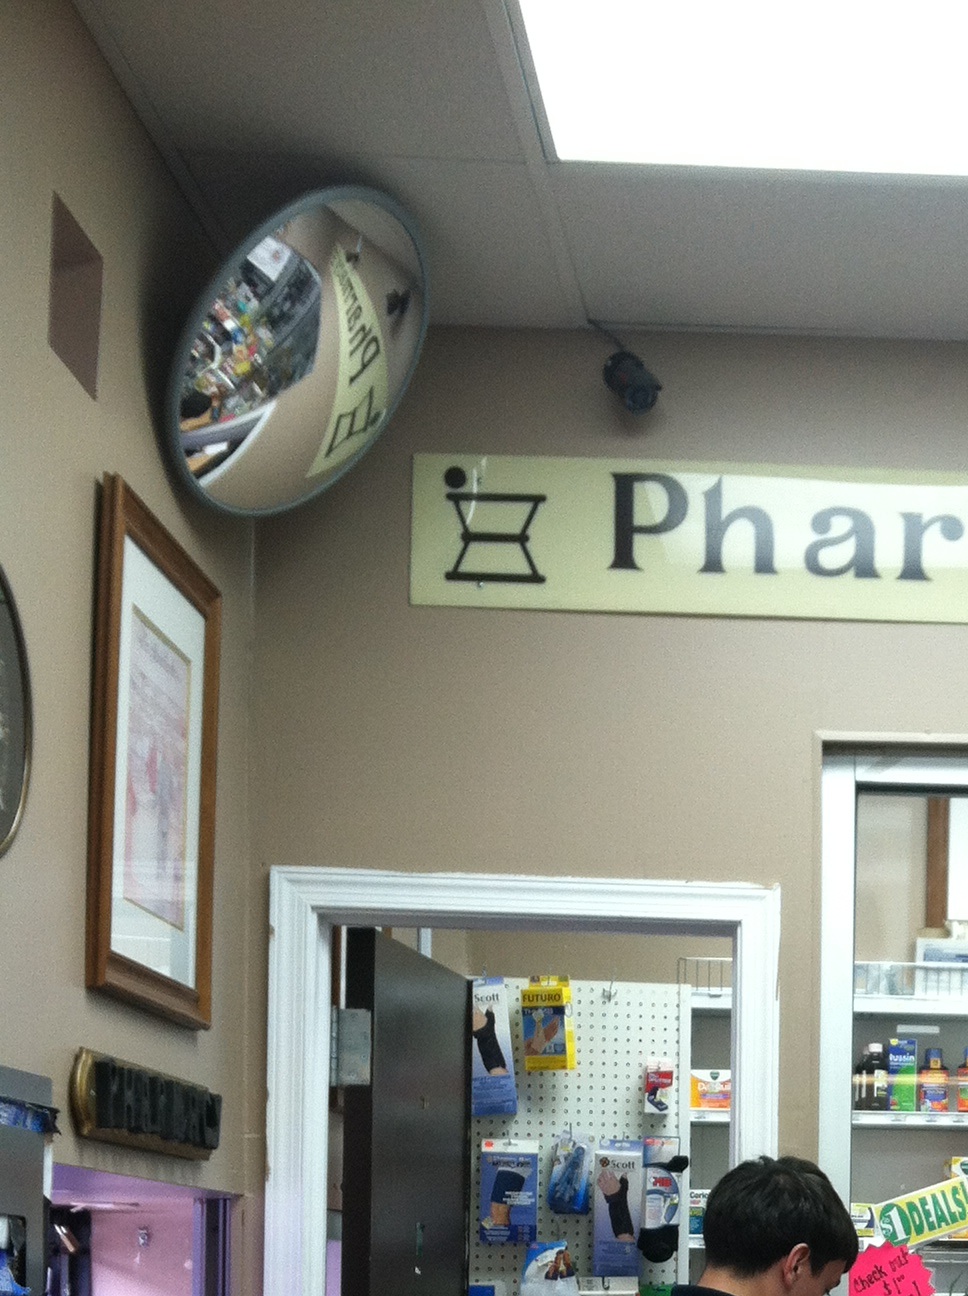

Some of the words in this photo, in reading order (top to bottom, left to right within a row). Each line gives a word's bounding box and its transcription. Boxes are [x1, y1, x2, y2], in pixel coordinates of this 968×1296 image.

[474, 992, 500, 1003] Scott
[522, 993, 562, 1003] FUTURO
[610, 1160, 636, 1170] Scott
[853, 1264, 888, 1294] Check
